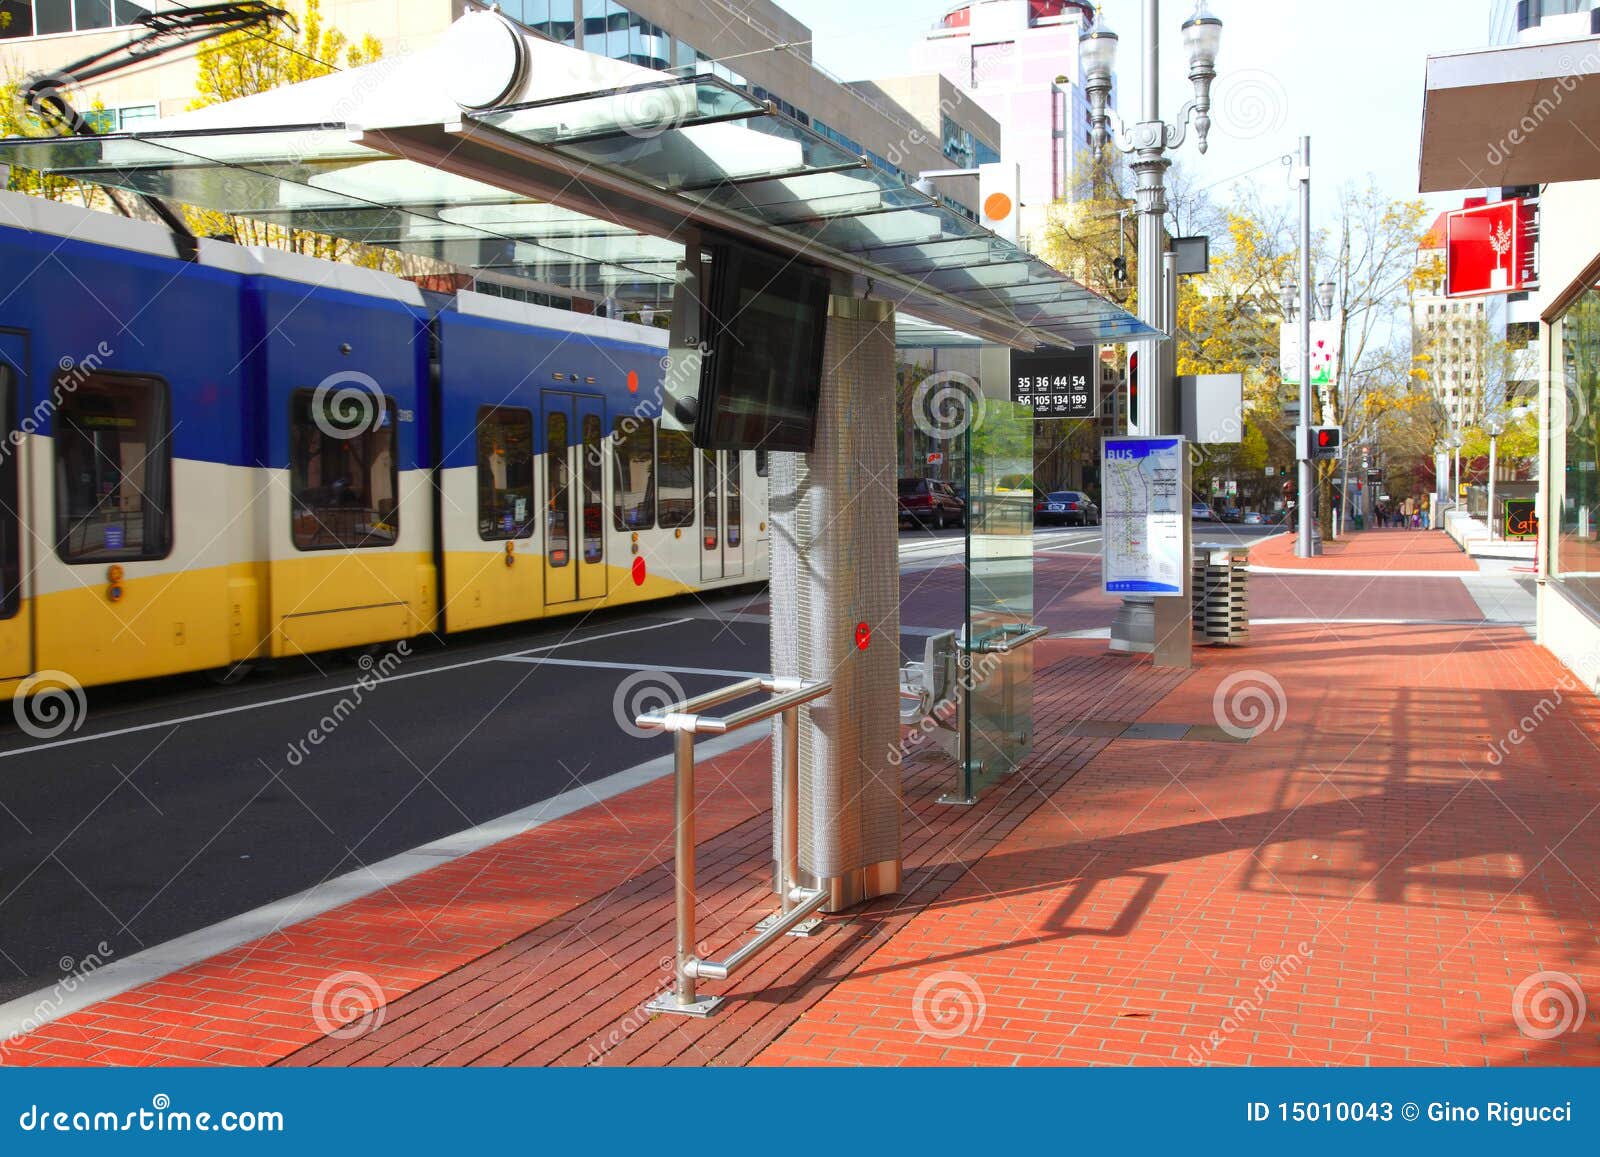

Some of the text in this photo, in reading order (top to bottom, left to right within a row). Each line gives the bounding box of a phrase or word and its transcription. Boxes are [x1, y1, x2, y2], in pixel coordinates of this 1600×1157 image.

[1018, 376, 1086, 388] 35 36 44 54
[1018, 395, 1087, 406] 56 105 134 199
[1107, 449, 1133, 460] BUS
